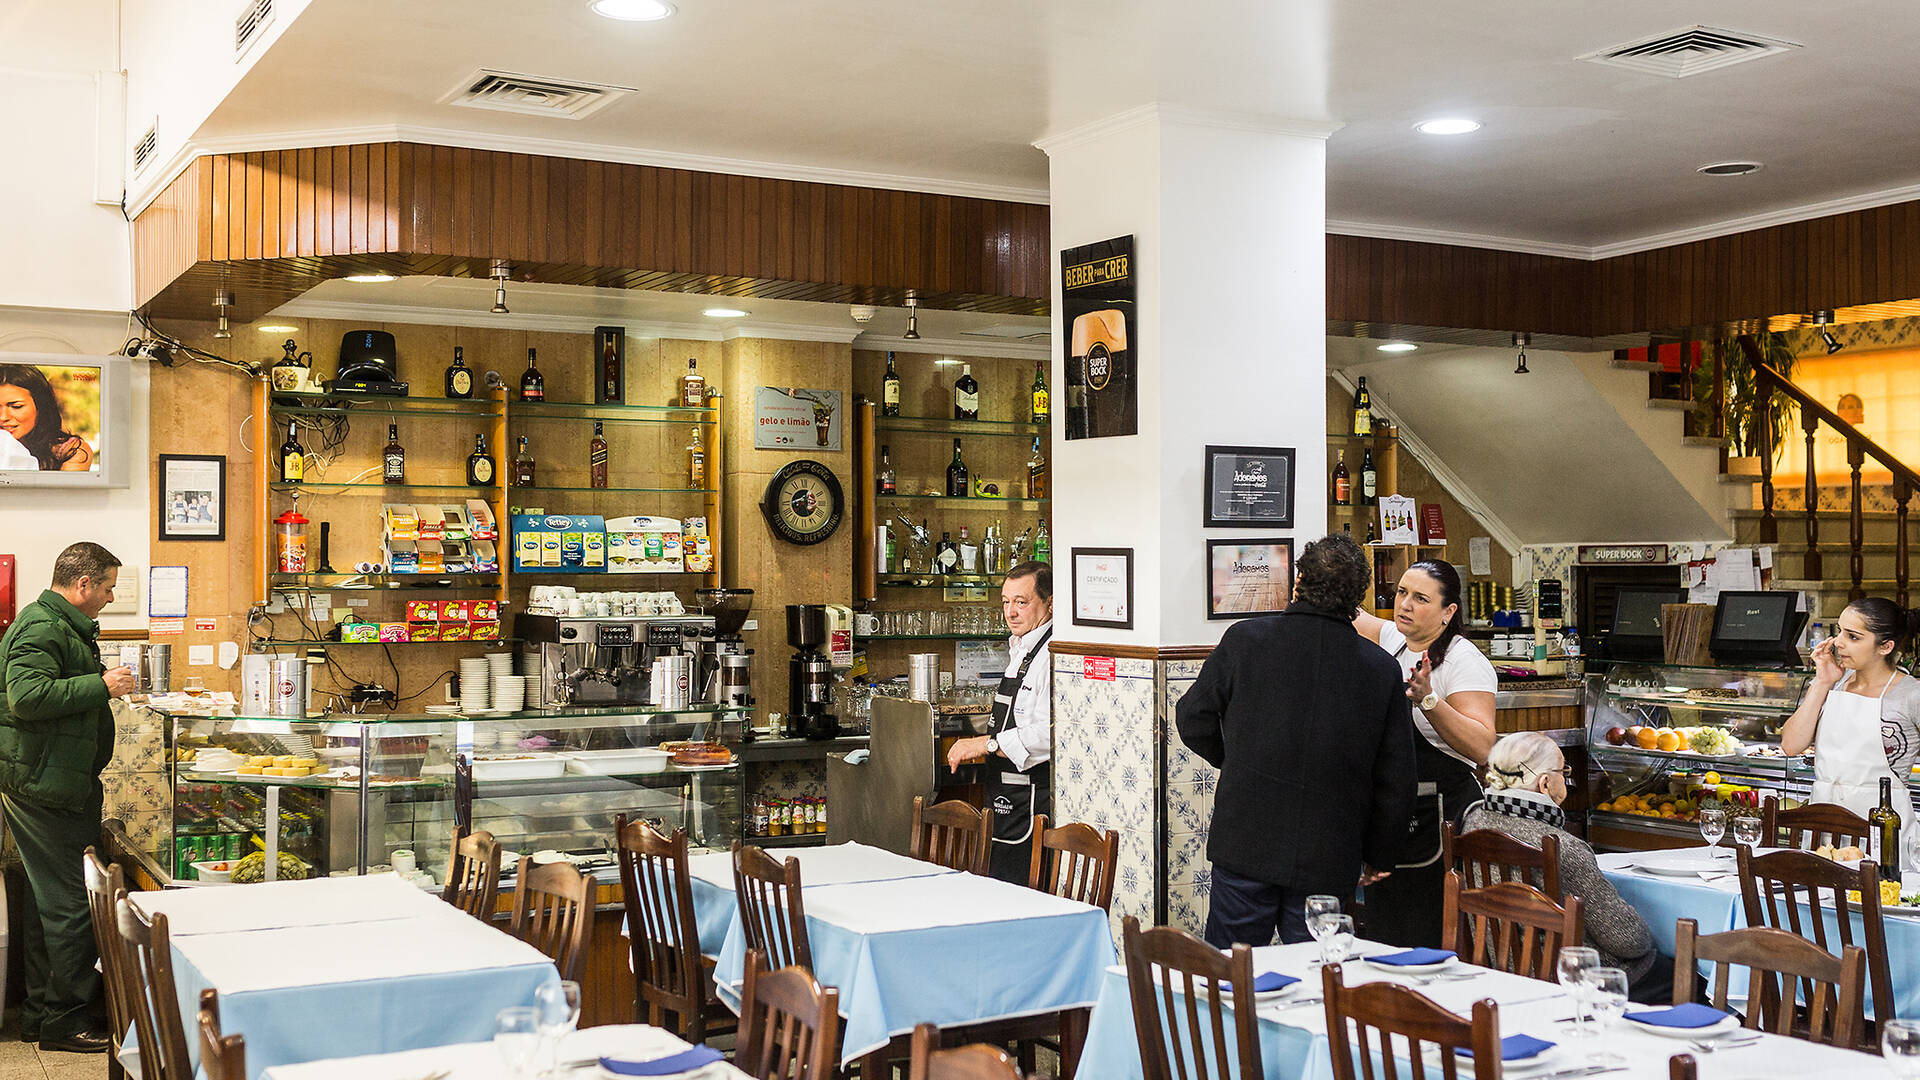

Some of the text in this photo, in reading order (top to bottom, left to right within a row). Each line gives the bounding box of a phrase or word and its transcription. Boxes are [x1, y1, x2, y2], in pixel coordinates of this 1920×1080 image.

[1066, 265, 1094, 287] BEBER
[1104, 257, 1128, 279] CRER
[1090, 357, 1107, 367] SUPER
[1090, 366, 1106, 376] BOCK
[759, 416, 778, 426] gelo
[787, 417, 811, 426] limão
[548, 518, 570, 527] Tetley
[1595, 549, 1643, 560] SUPER BOCK
